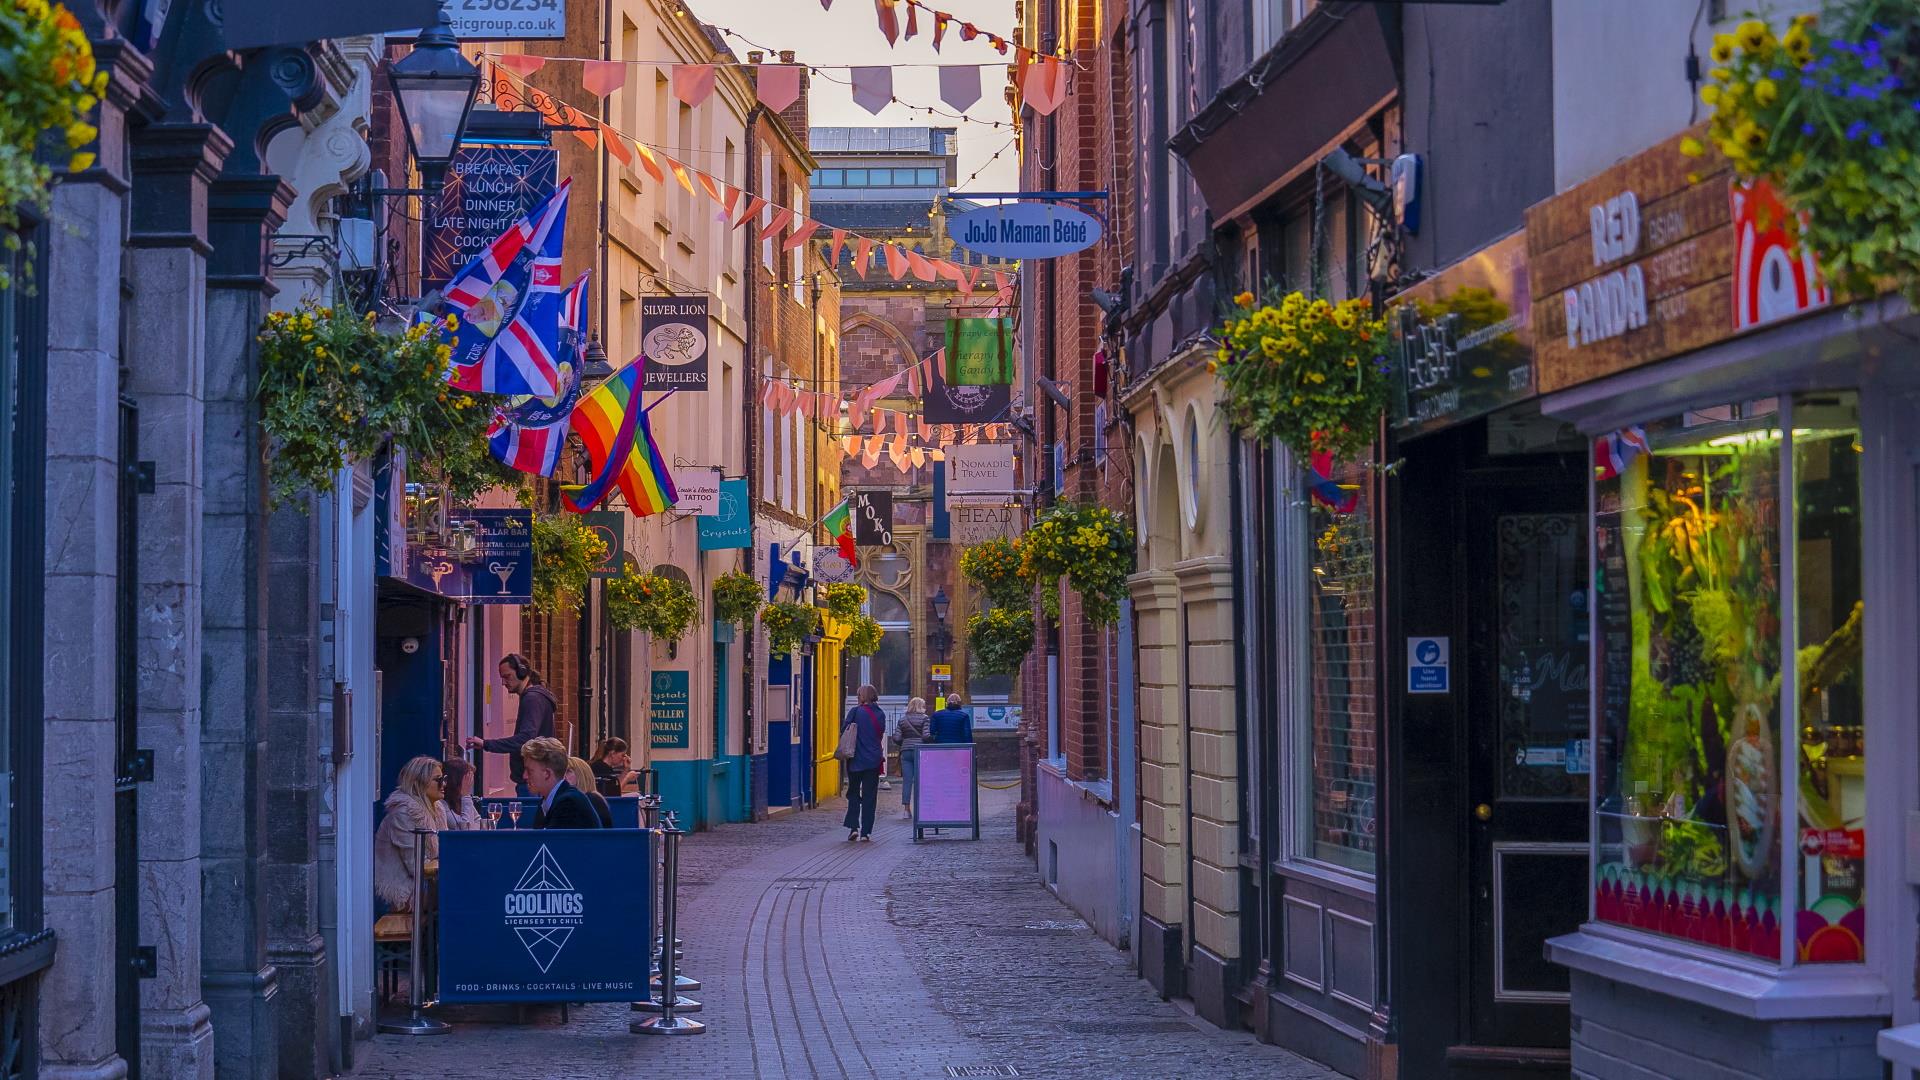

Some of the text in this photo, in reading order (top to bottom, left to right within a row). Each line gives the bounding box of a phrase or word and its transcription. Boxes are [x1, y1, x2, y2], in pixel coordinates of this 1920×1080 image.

[455, 162, 529, 176] BREAKFAST
[469, 181, 513, 193] LUNCH
[465, 199, 515, 211] DINNER
[434, 217, 465, 228] LATE
[468, 218, 508, 230] NIGHT
[1590, 191, 1641, 267] RED
[1649, 208, 1685, 246] ASIAN
[965, 219, 1087, 243] JoJo Maman Bébé
[454, 236, 497, 248] COCKT
[1651, 240, 1697, 286] STREET
[643, 304, 706, 315] SILVER LION
[1563, 263, 1649, 350] PANDA
[644, 372, 707, 385] JEWELLERS
[961, 459, 1010, 469] NOMADIC
[961, 469, 998, 478] TRAVEL
[857, 493, 892, 545] MOKO
[958, 508, 1013, 522] HEAD
[511, 528, 528, 536] BAR
[701, 528, 748, 538] Crystals
[651, 690, 687, 701] ystals
[650, 709, 685, 719] WELLERY
[651, 722, 684, 731] INERALS
[504, 893, 583, 914] COOLINGS
[486, 983, 520, 991] DRINKS
[582, 982, 601, 990] LIVE
